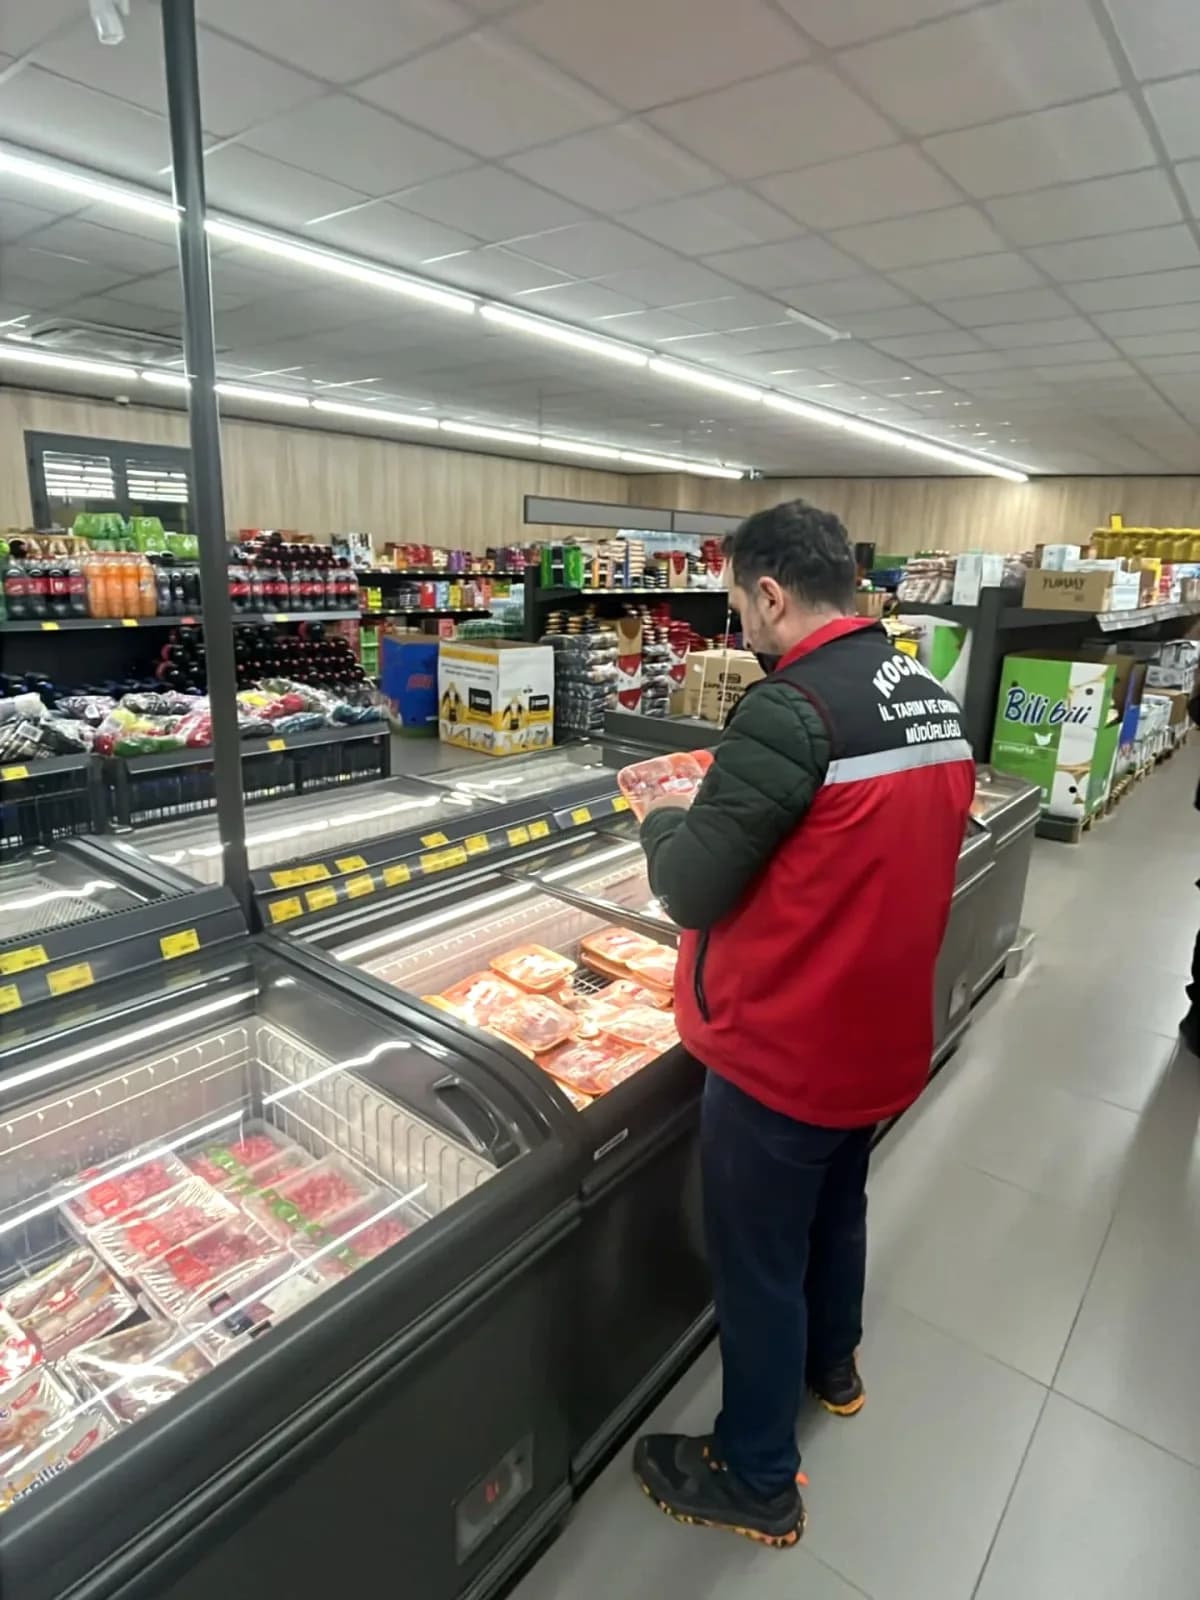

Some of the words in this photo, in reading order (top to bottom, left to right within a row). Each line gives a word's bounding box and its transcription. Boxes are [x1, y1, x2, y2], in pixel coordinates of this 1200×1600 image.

[924, 698, 940, 714] VE
[1004, 687, 1049, 725] Bili
[1049, 700, 1093, 725] bili
